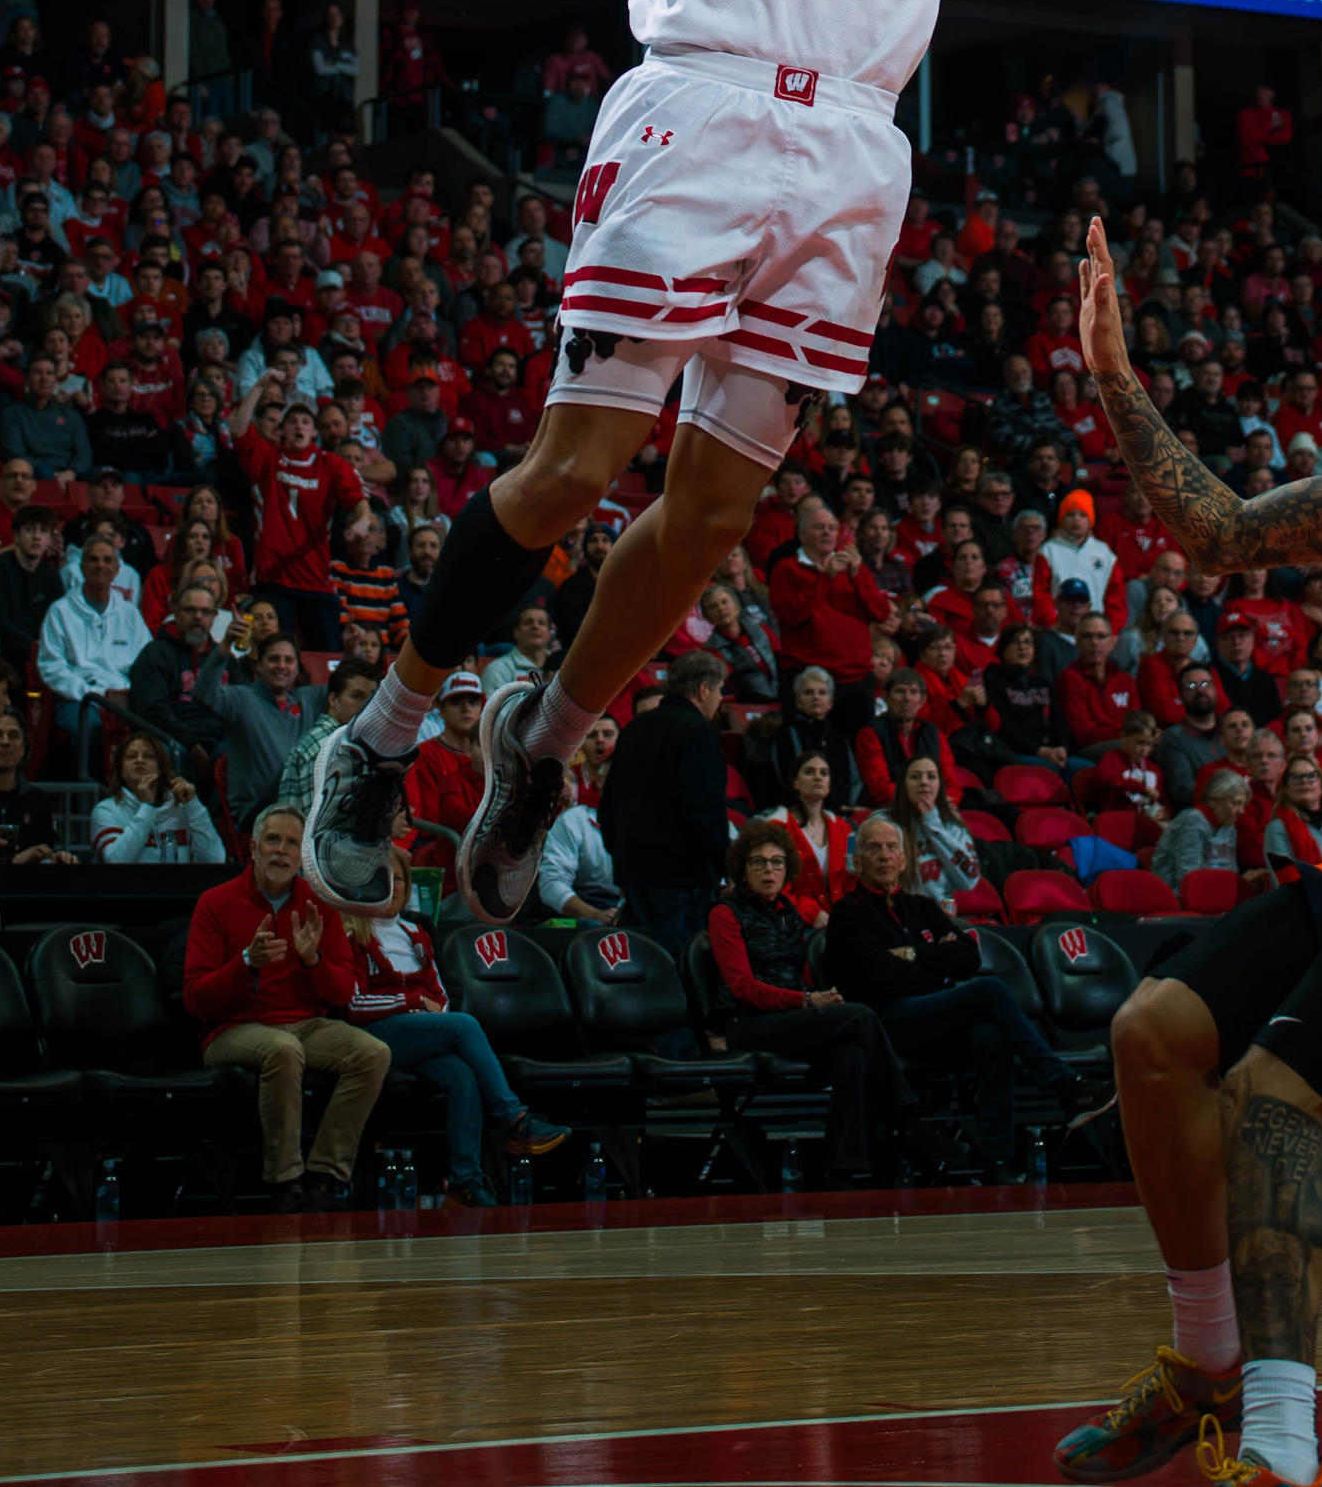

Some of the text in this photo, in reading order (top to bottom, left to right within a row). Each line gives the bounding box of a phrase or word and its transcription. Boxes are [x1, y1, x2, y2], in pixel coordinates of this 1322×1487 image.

[70, 931, 106, 969] W
[474, 929, 509, 969] W
[597, 931, 631, 971] W
[1057, 927, 1087, 964] W
